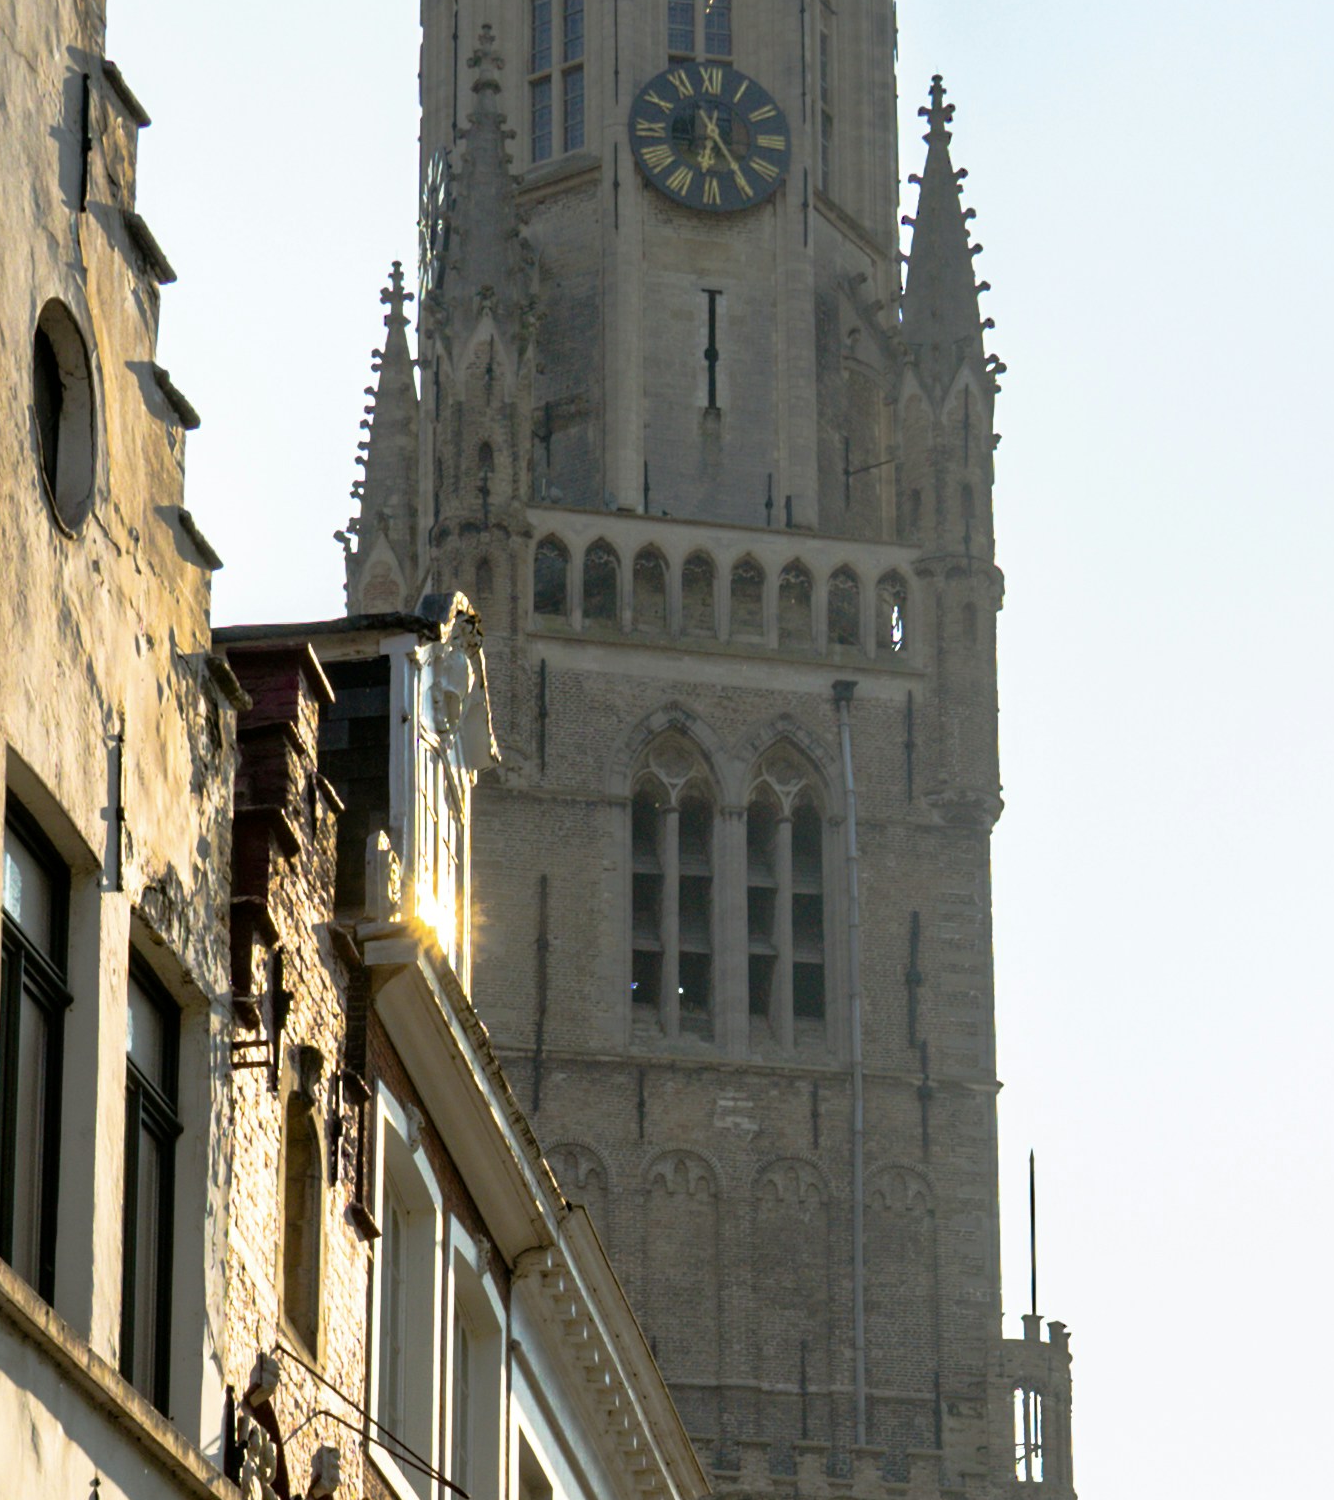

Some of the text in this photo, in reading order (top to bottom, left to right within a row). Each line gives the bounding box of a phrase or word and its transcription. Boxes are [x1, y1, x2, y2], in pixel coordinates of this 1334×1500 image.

[667, 68, 695, 99] XI
[699, 66, 723, 95] XII
[643, 89, 675, 115] X
